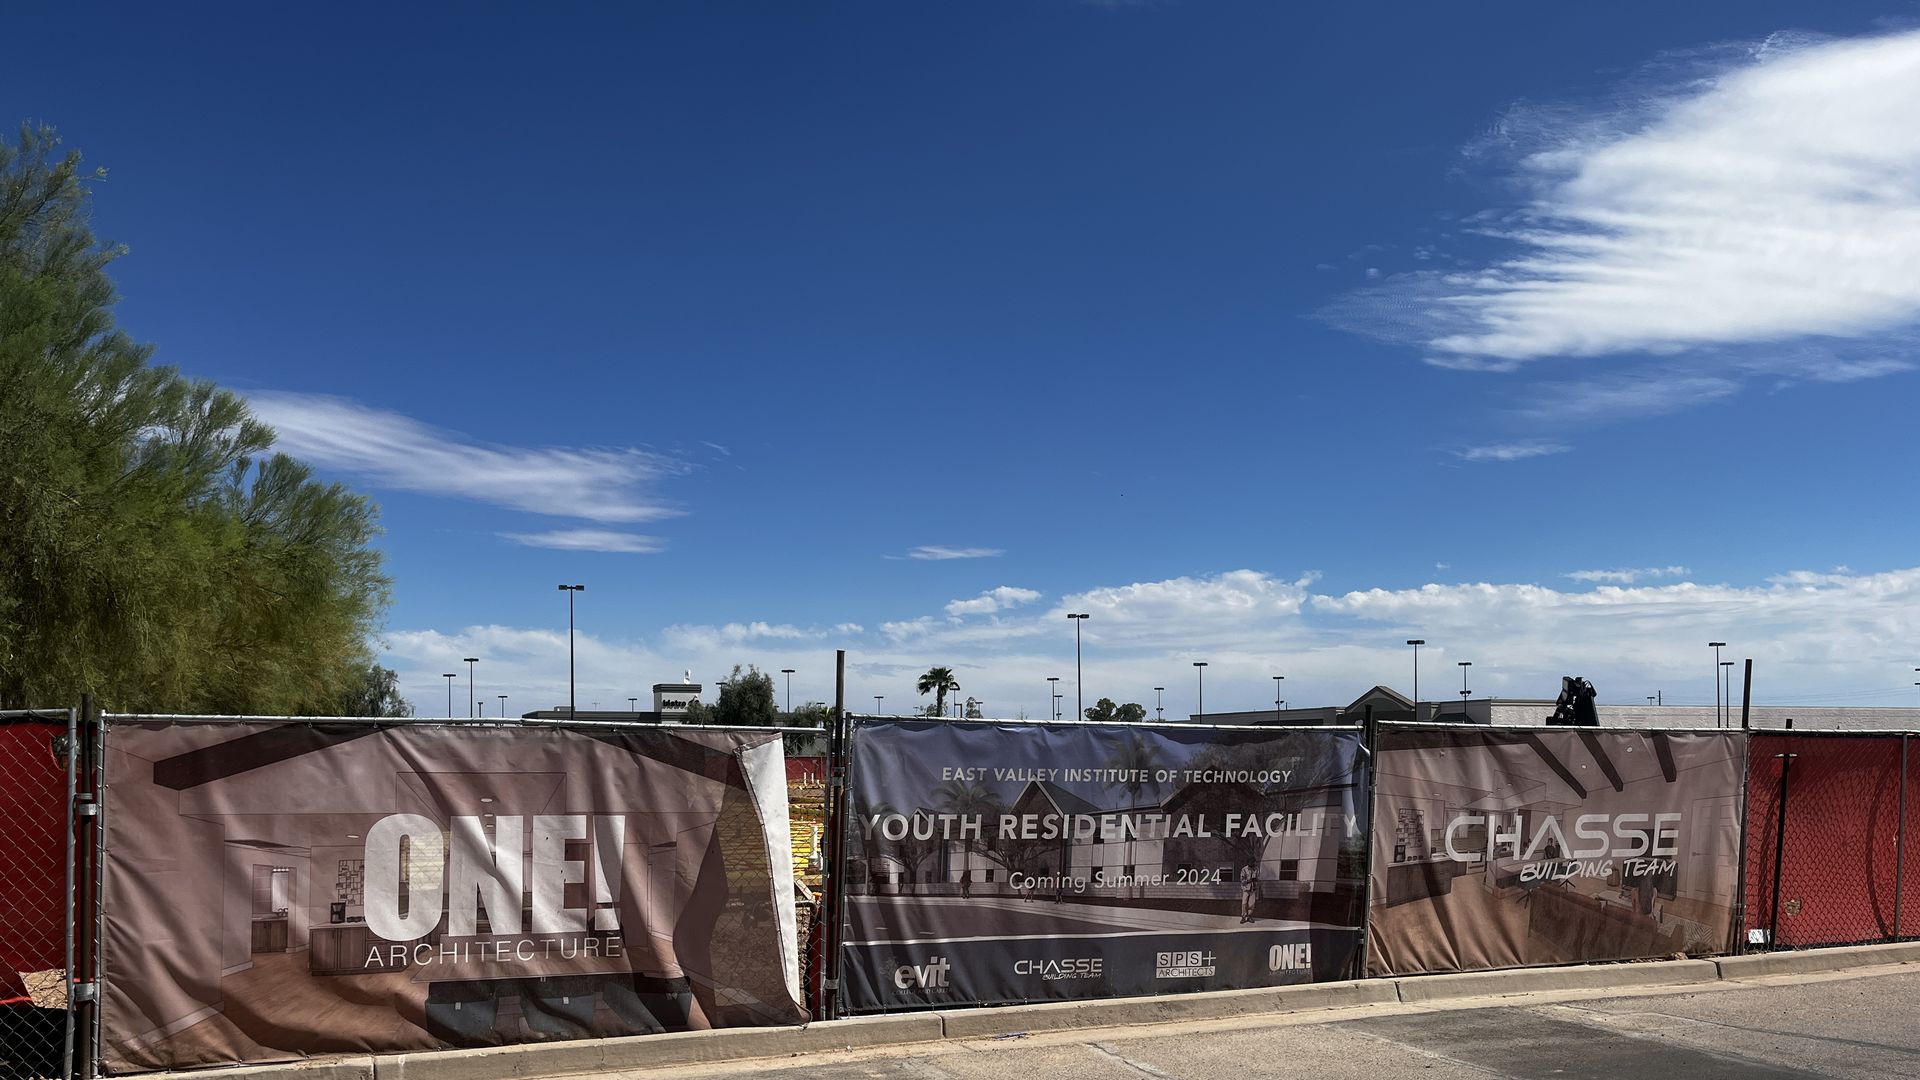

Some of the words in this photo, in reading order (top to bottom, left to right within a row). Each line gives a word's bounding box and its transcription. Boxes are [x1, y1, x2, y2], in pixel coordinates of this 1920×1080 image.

[663, 699, 686, 707] bistro
[942, 768, 988, 781] EAST
[994, 768, 1059, 782] VALLEY
[1064, 768, 1149, 783] INSTITUTE
[1156, 769, 1178, 782] OF
[1184, 770, 1292, 783] TECHNOLOGY
[859, 814, 982, 840] YOUTH
[999, 813, 1211, 840] RESIDENTIAL
[1226, 812, 1357, 839] FACILITY
[1445, 812, 1682, 862] CHASSE
[363, 813, 626, 942] ONE!
[1009, 872, 1087, 894] Coming
[1094, 870, 1170, 888] Summer
[1177, 868, 1221, 886] 2024
[1519, 859, 1613, 883] BUILDING
[1623, 857, 1677, 878] TEAM
[364, 936, 622, 968] ARCHITECTURE
[1269, 943, 1312, 971] ONE!
[895, 956, 950, 989] evit
[1014, 958, 1103, 975] CHASSE
[1158, 966, 1215, 977] ARCHITECTS
